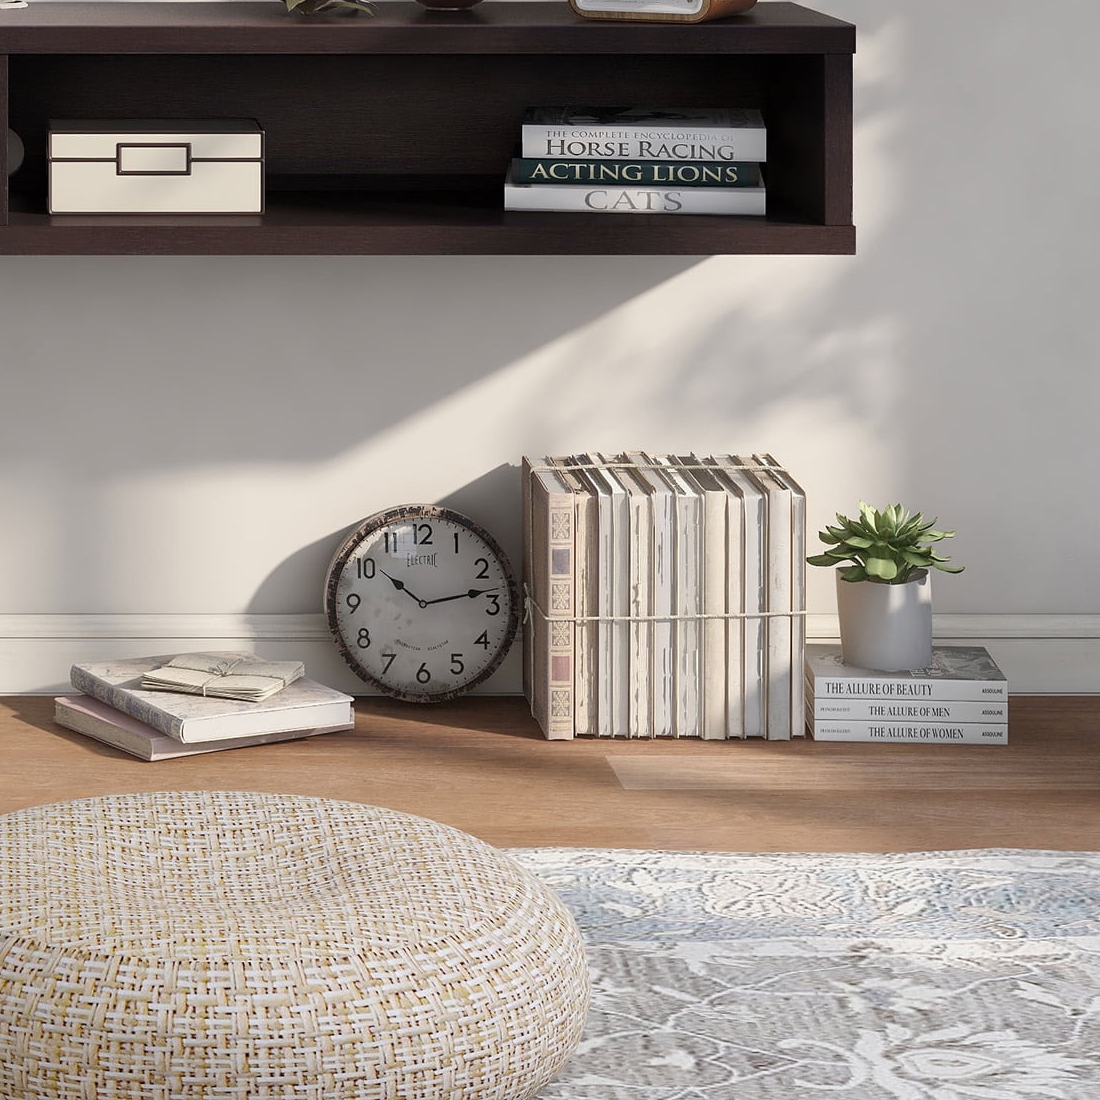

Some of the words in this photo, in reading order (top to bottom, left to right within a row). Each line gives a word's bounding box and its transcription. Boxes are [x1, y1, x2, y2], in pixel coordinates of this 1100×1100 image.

[546, 130, 568, 138] THE
[571, 130, 630, 139] COMPLETE
[634, 131, 718, 141] ENCYCLOPEDIA
[546, 139, 630, 157] HORSE
[638, 140, 735, 161] RACING
[529, 162, 643, 182] ACTING
[652, 164, 738, 183] LIONS
[584, 190, 683, 212] CATS
[384, 532, 398, 553] 11
[412, 523, 433, 545] 12
[453, 532, 459, 554] 1
[356, 557, 376, 579] 10
[406, 552, 438, 568] ELECTRIC
[474, 558, 490, 579] 2
[346, 593, 361, 614] 9
[485, 594, 500, 616] 3
[356, 628, 371, 649] 8
[473, 629, 491, 650] 4
[381, 653, 397, 675] 7
[416, 662, 431, 684] 6
[450, 653, 465, 675] 5
[825, 682, 844, 694] THE
[846, 683, 881, 695] ALLURE
[882, 684, 895, 695] OF
[896, 684, 933, 696] BEAUTY
[869, 706, 886, 716] THE
[887, 707, 918, 717] ALLURE
[919, 707, 932, 717] OF
[931, 707, 951, 718] MEN
[868, 727, 886, 738] THE
[887, 727, 918, 738] ALLURE
[919, 728, 932, 739] OF
[931, 728, 965, 740] WOMEN
